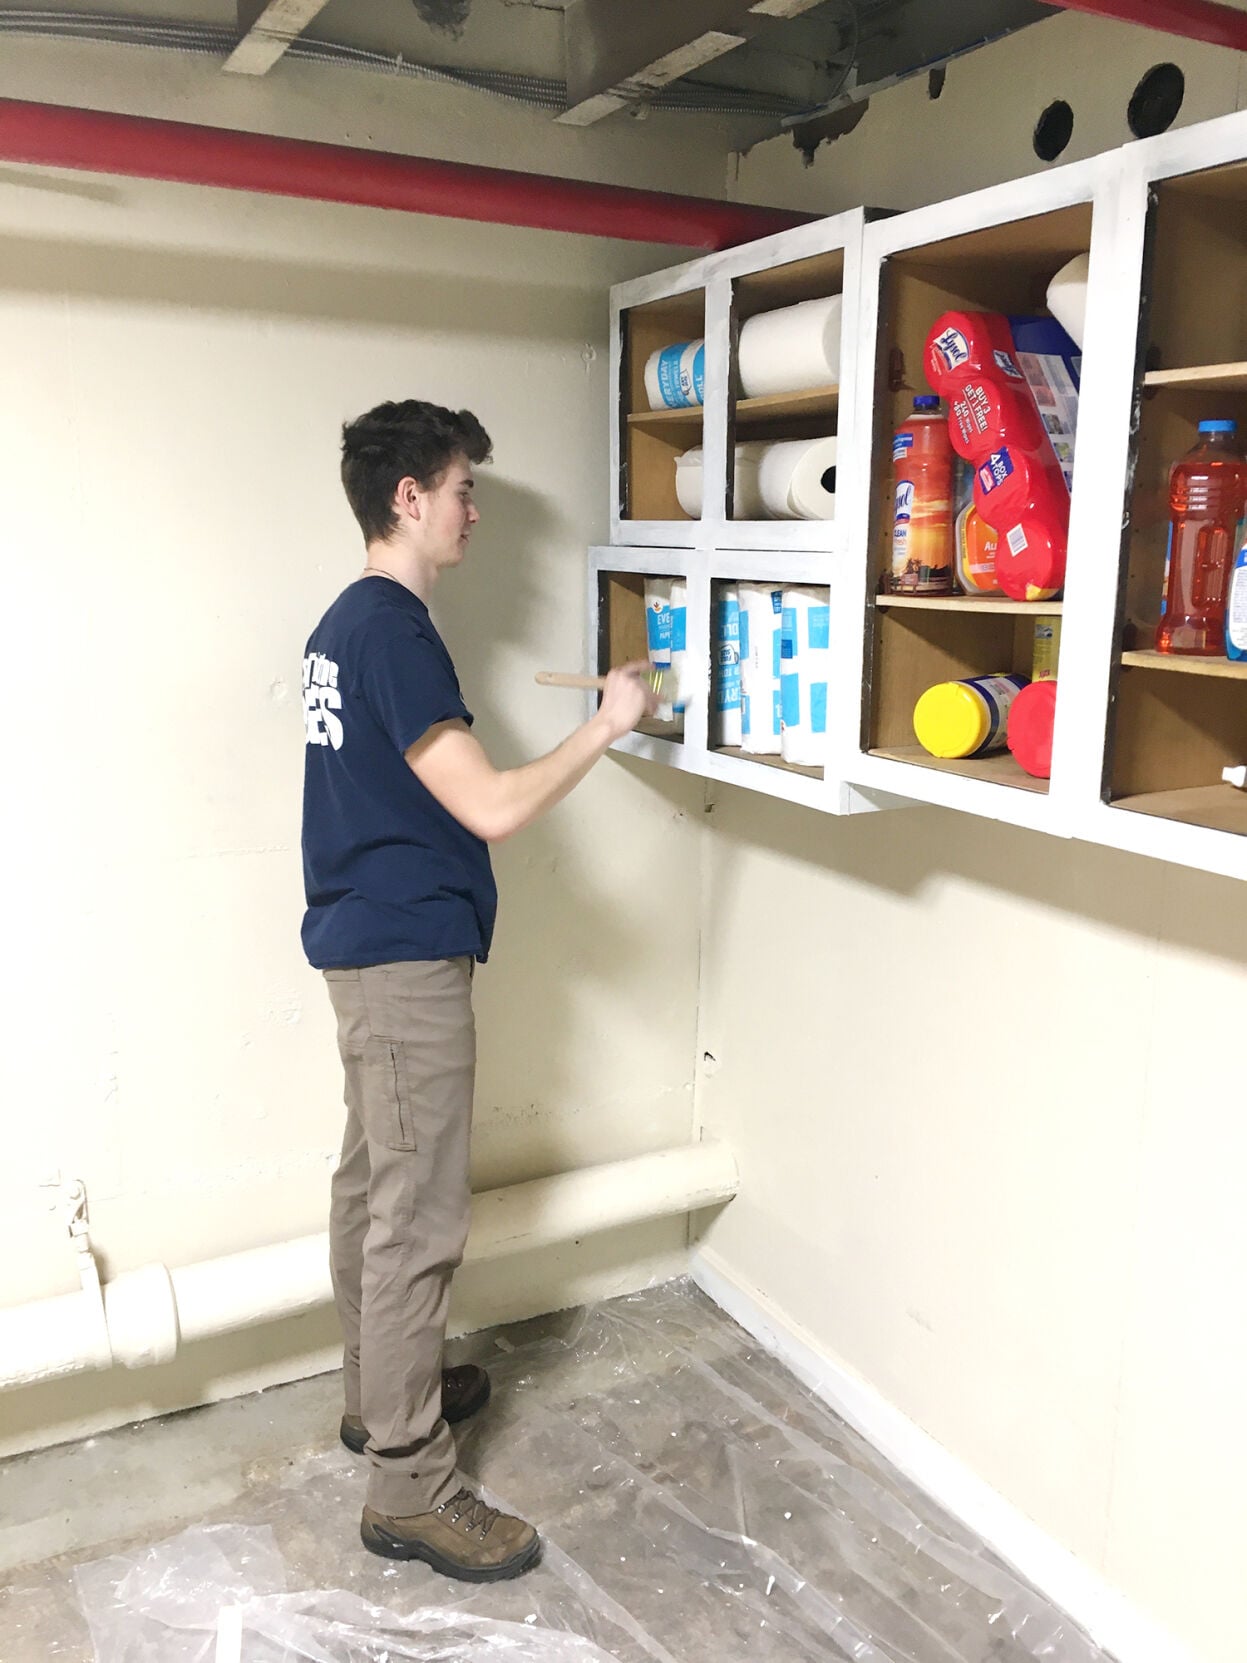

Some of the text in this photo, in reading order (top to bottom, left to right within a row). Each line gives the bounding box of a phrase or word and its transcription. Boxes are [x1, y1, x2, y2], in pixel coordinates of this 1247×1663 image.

[940, 329, 967, 362] Lysol
[960, 401, 969, 417] 240
[965, 384, 976, 401] GET
[974, 405, 988, 431] FREE!
[975, 386, 991, 414] BUY 3
[990, 454, 1008, 478] 4 BOX
